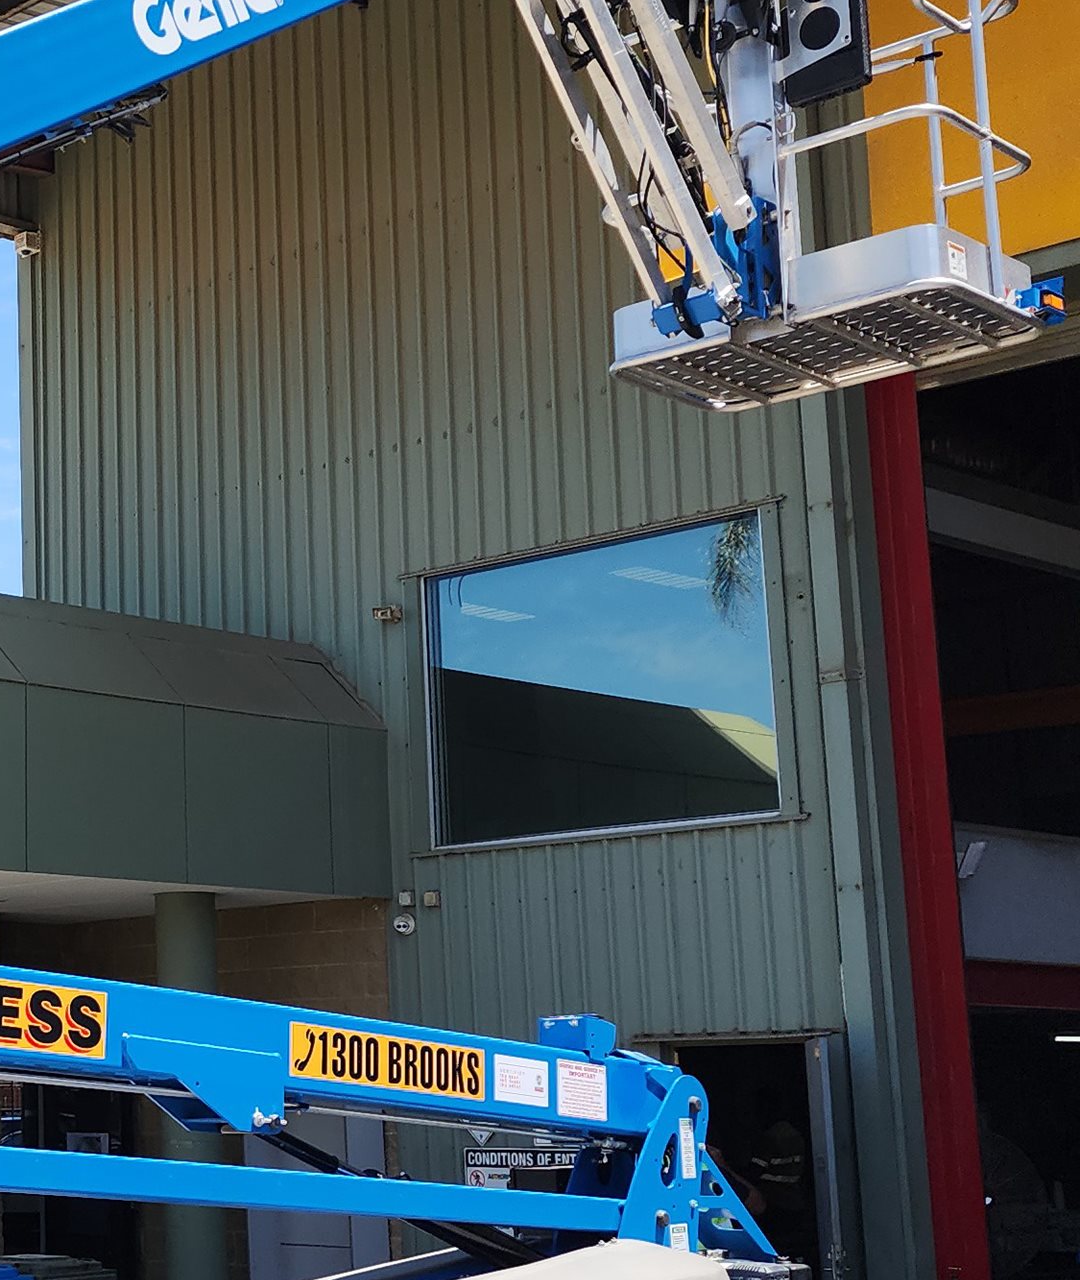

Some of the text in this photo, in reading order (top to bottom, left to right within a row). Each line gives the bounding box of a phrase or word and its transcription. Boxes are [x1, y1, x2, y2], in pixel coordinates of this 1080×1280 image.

[318, 1031, 480, 1096] 1300 BROOKS
[467, 1151, 577, 1166] CONDITIONS OF ENT
